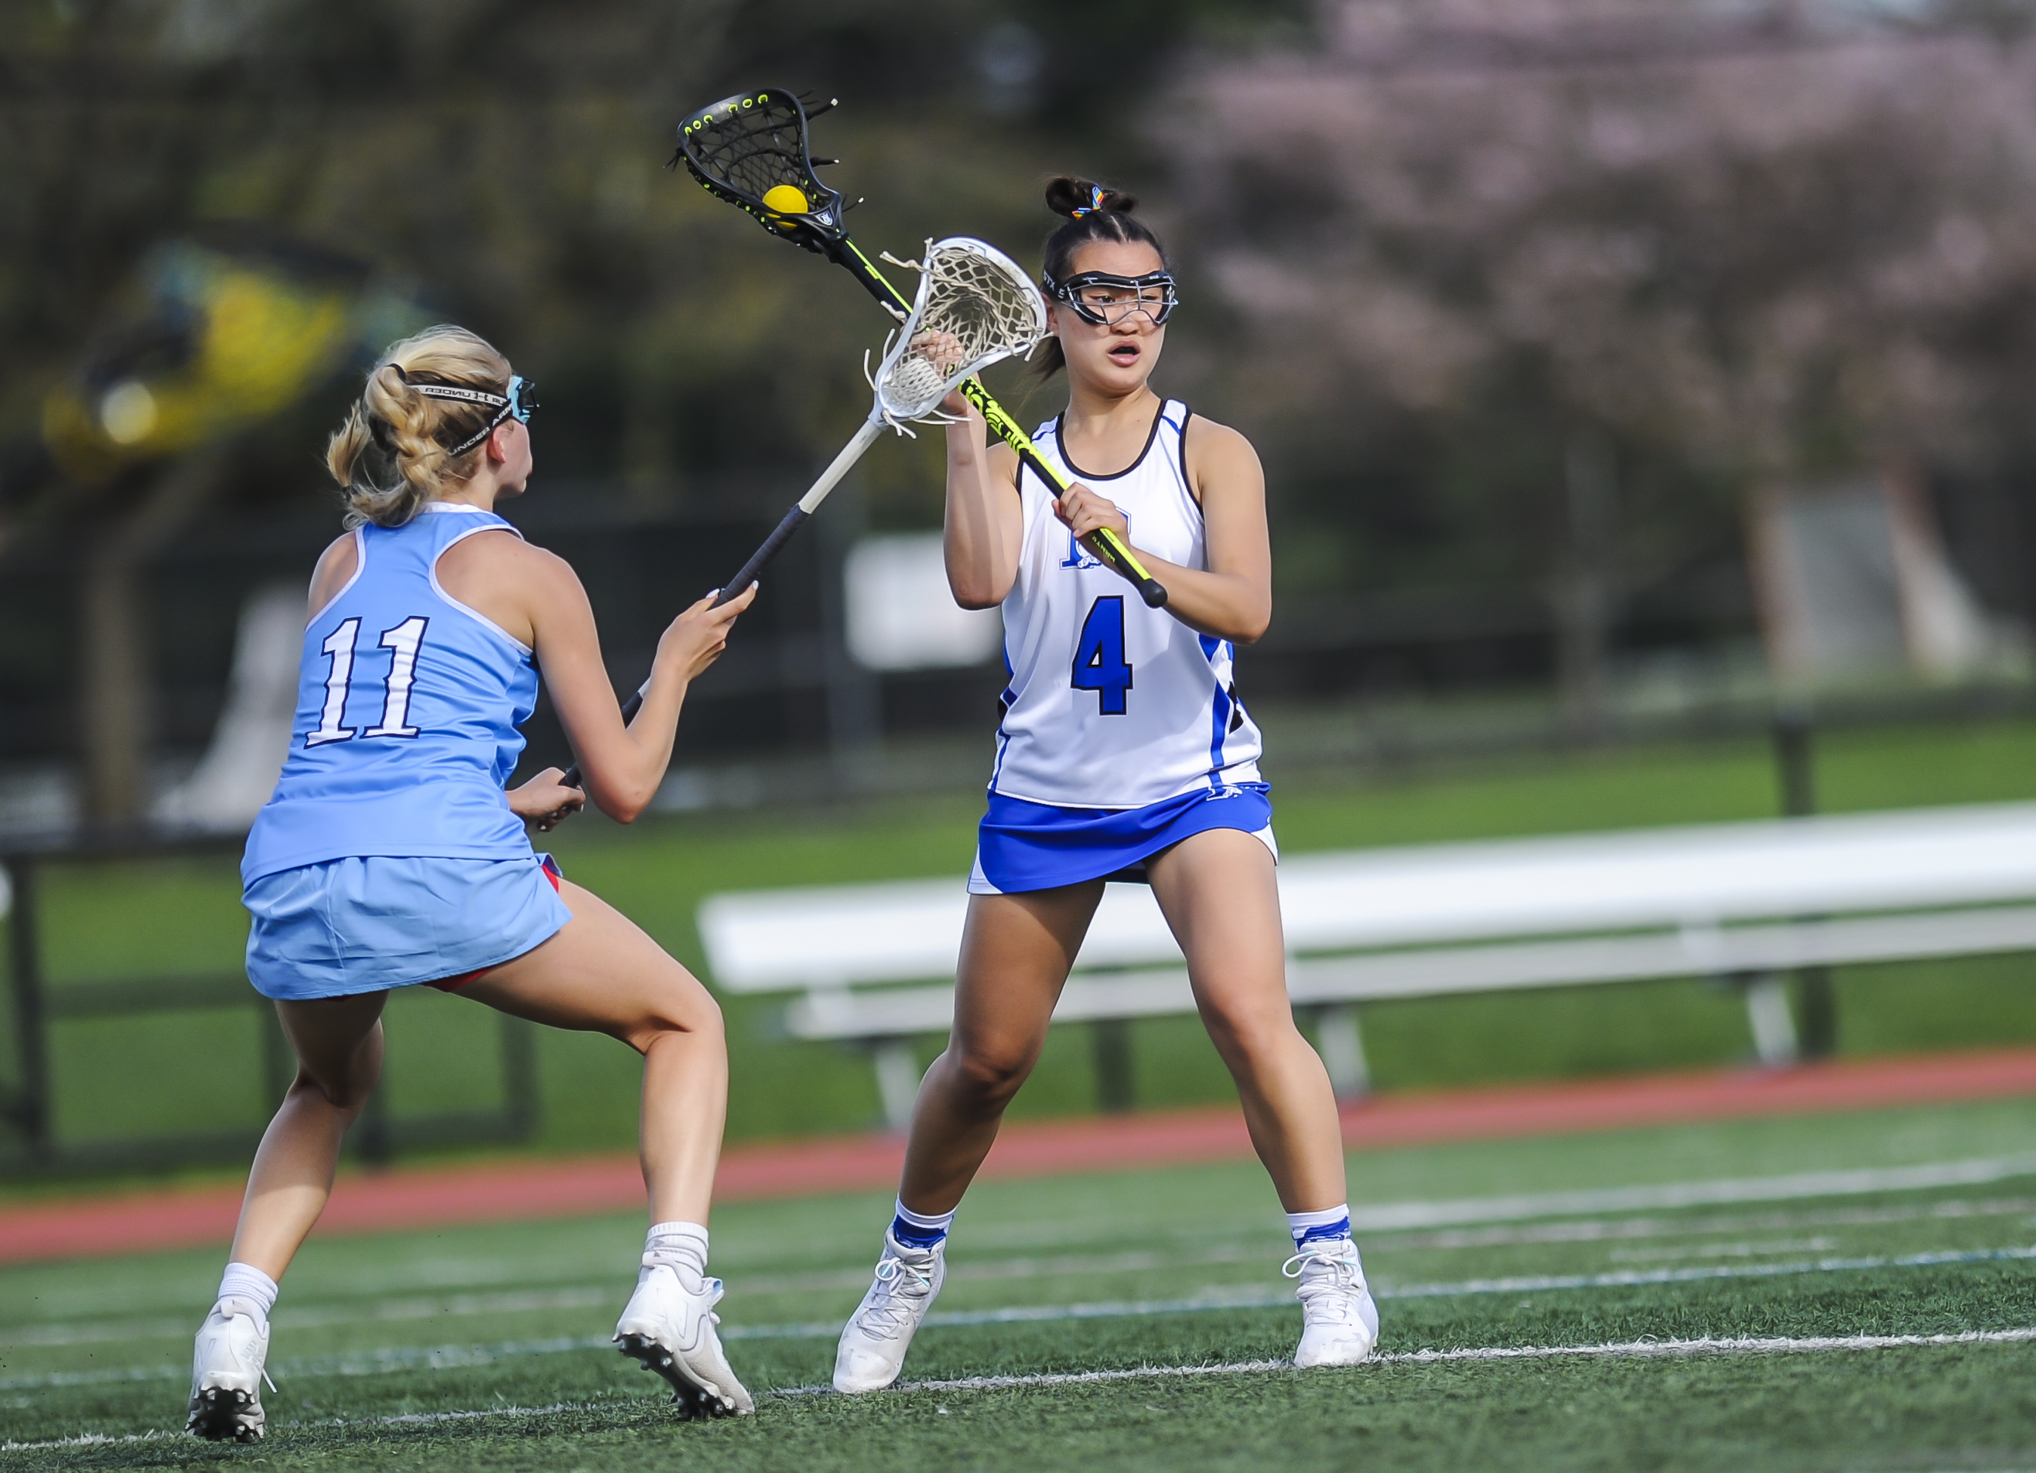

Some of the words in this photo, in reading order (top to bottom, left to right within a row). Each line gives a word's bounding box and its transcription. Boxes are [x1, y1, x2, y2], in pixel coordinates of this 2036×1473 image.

[492, 404, 513, 427] ARM
[303, 615, 431, 750] 11
[1070, 595, 1133, 716] 4
